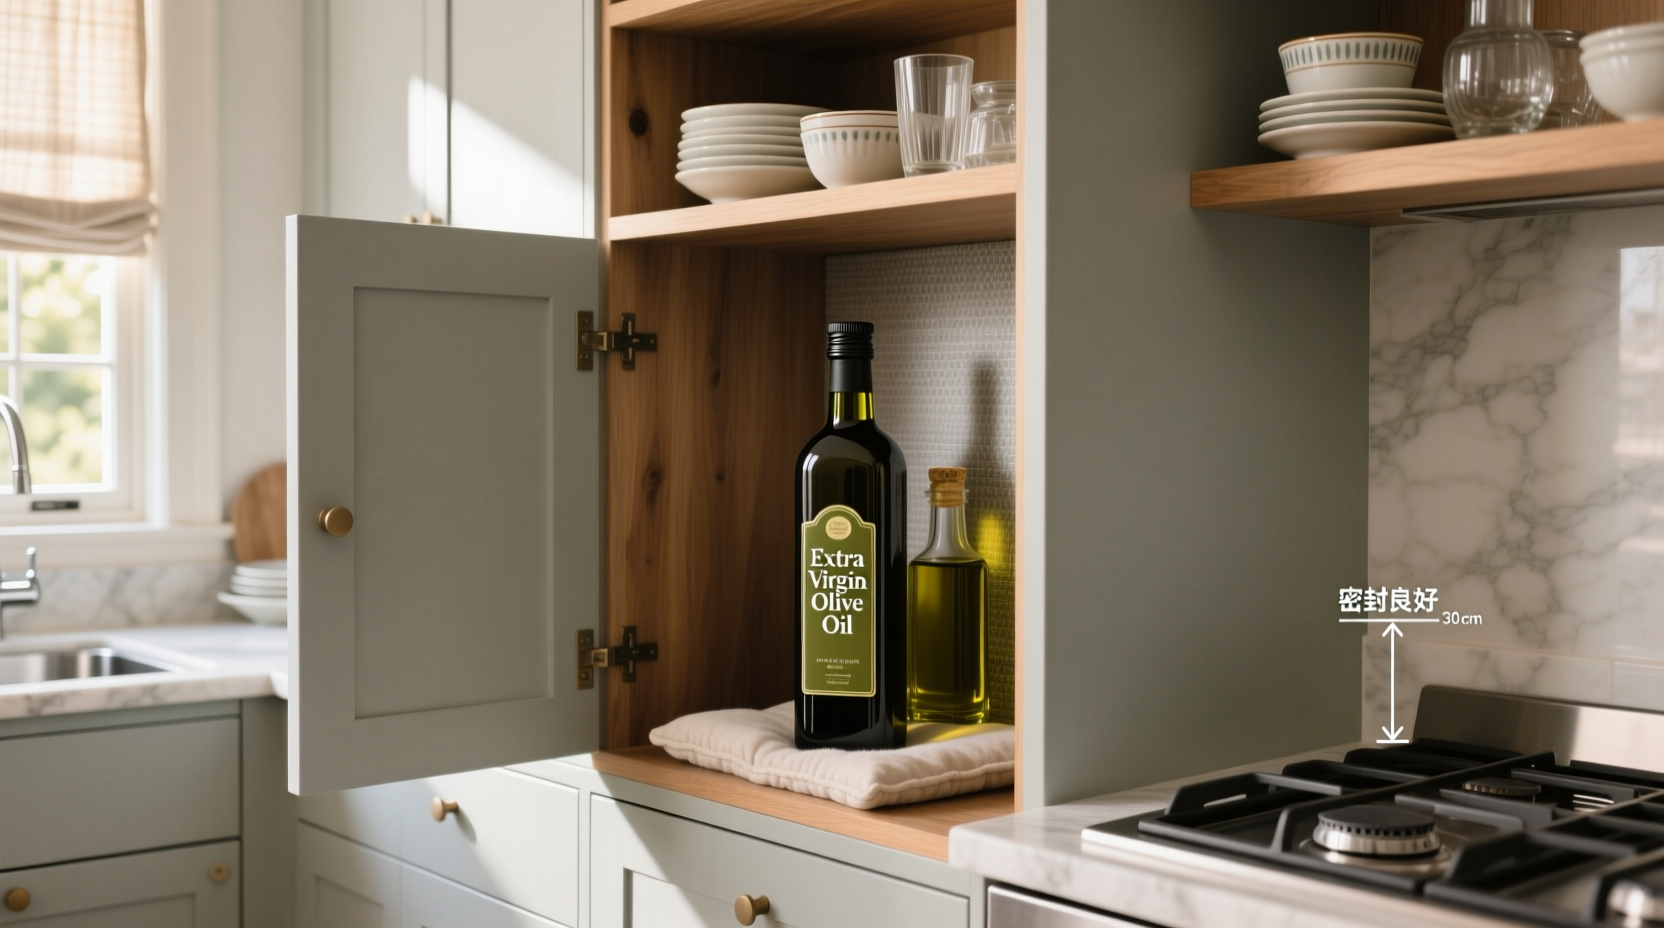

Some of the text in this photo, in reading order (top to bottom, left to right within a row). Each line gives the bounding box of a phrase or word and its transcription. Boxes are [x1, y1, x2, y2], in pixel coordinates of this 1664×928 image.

[810, 548, 865, 567] Extra
[807, 569, 868, 594] Virgin
[811, 592, 864, 612] Olive
[822, 614, 854, 635] Oil
